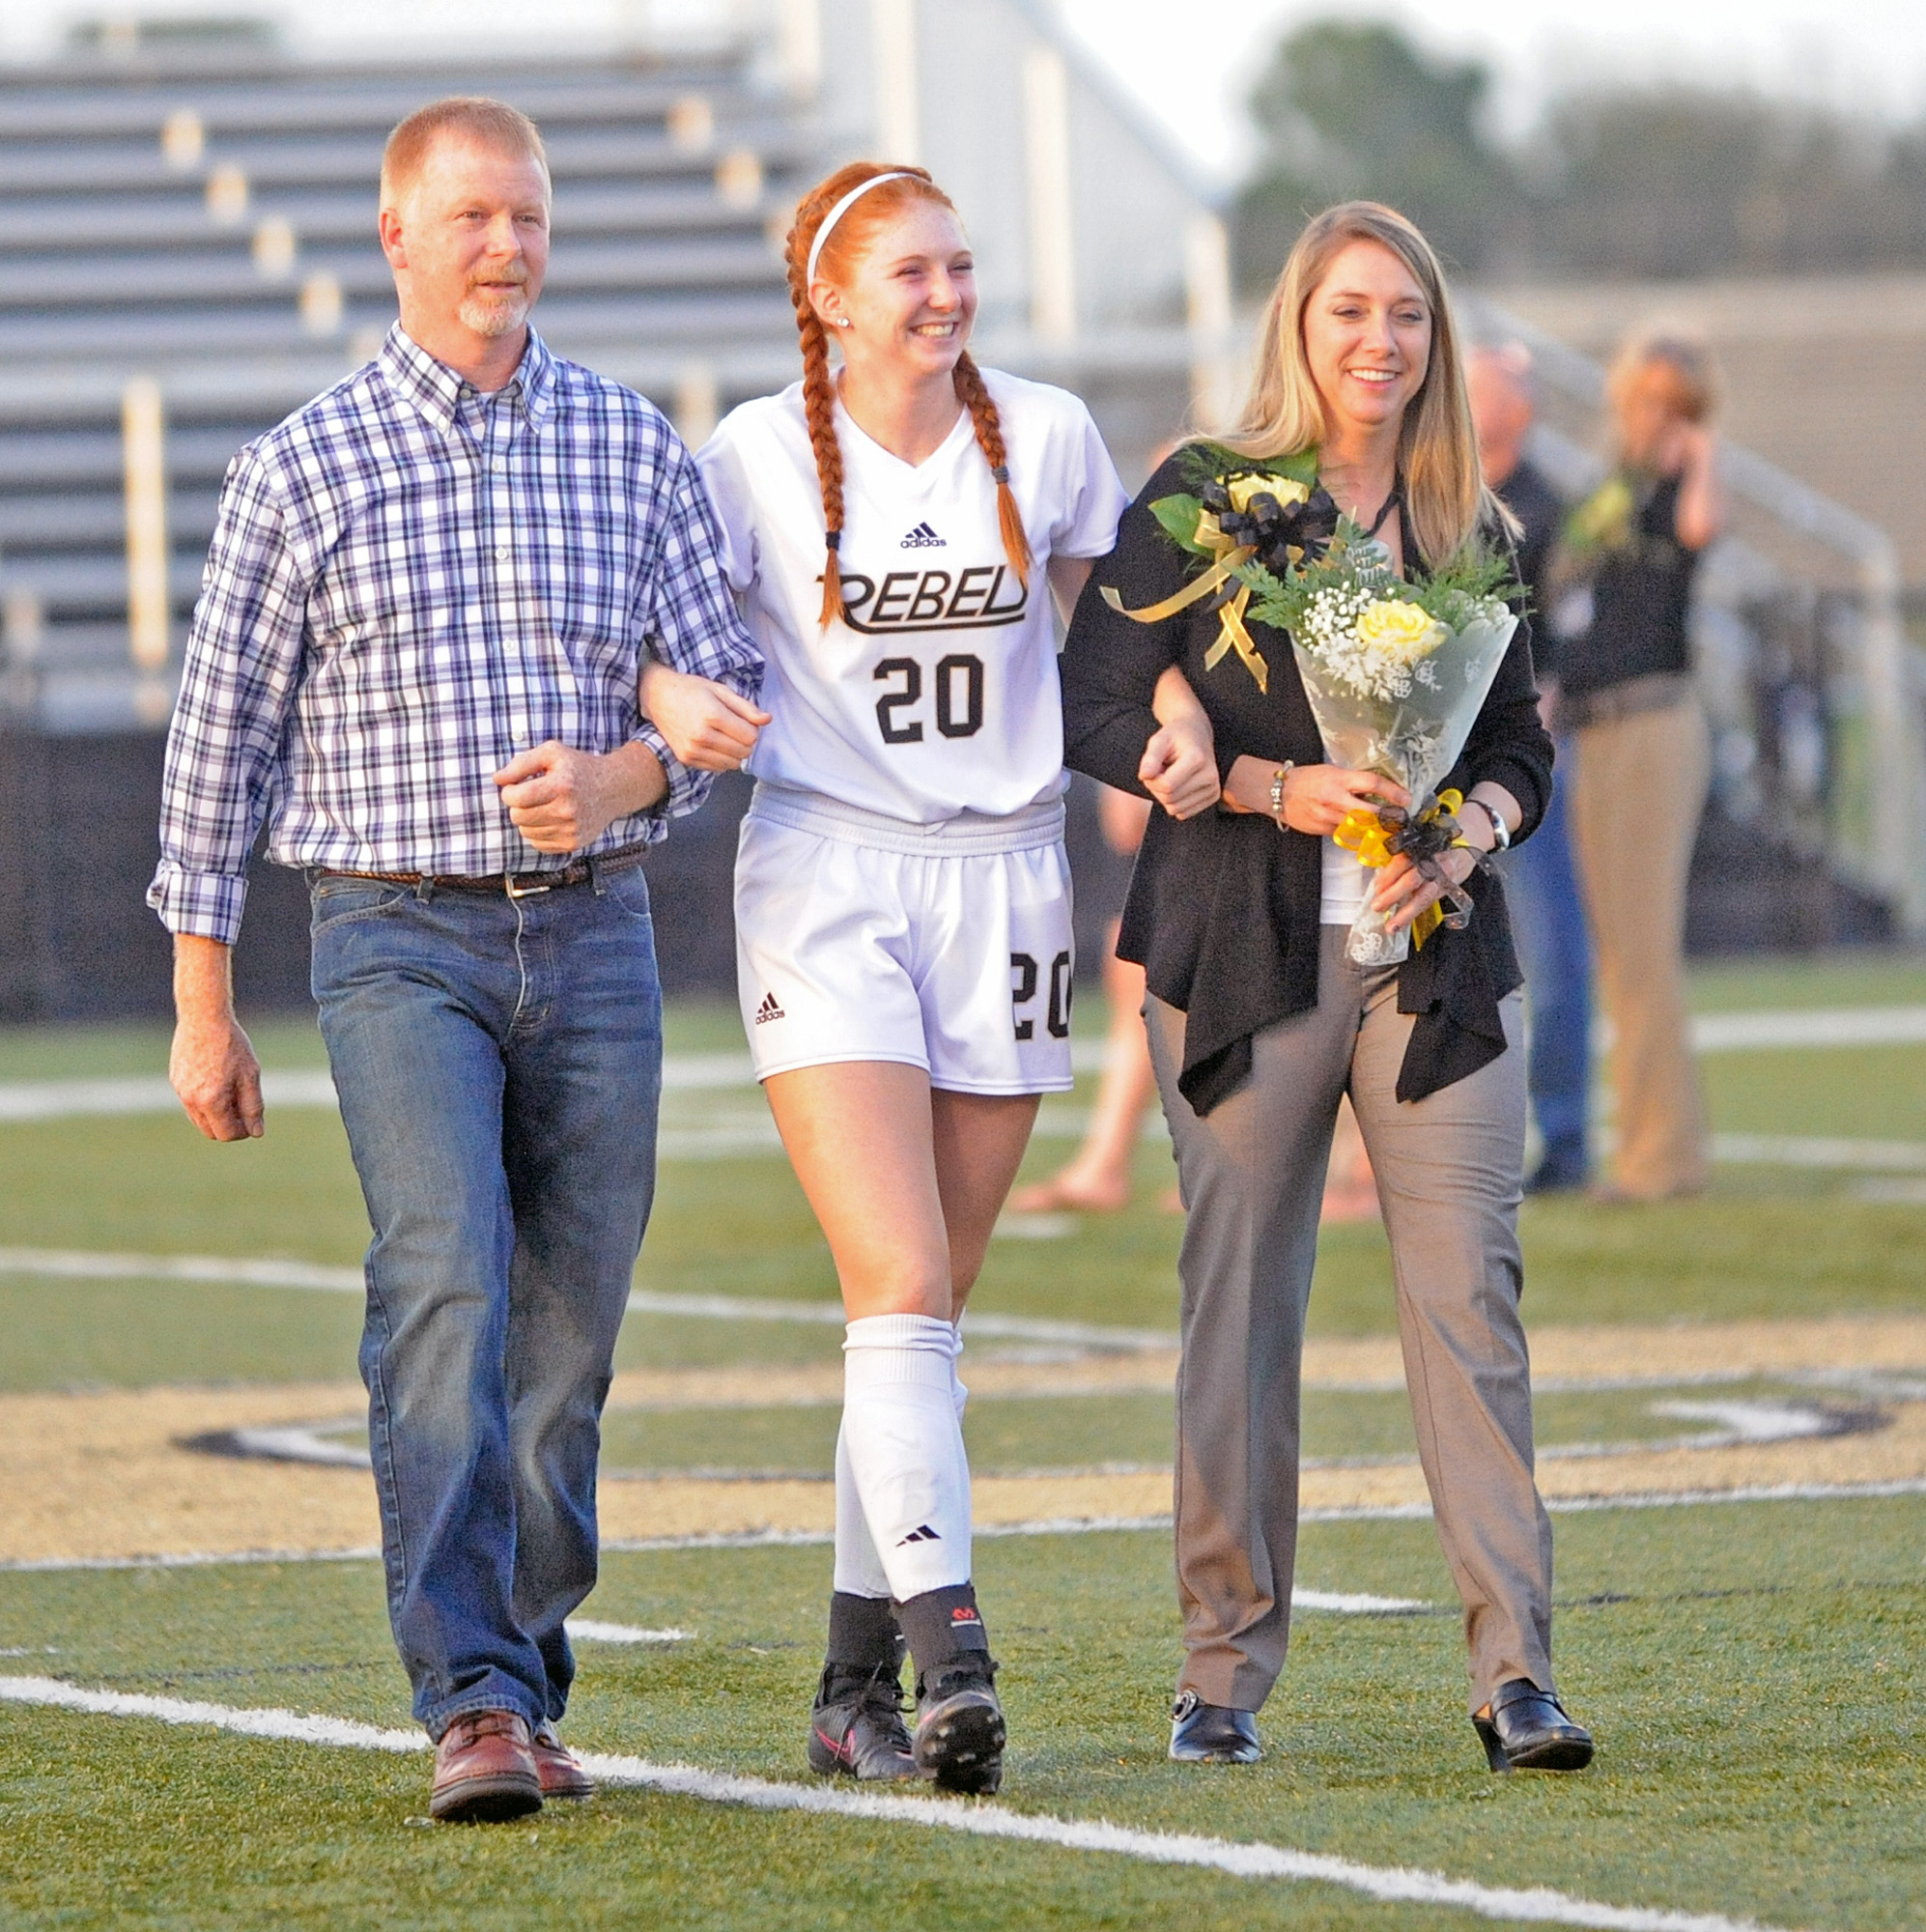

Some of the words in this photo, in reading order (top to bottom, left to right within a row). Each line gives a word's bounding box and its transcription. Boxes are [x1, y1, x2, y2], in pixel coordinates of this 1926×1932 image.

[900, 537, 947, 549] adidas
[873, 654, 983, 744] 20
[755, 1009, 785, 1025] adidas
[1010, 951, 1072, 1039] 20
